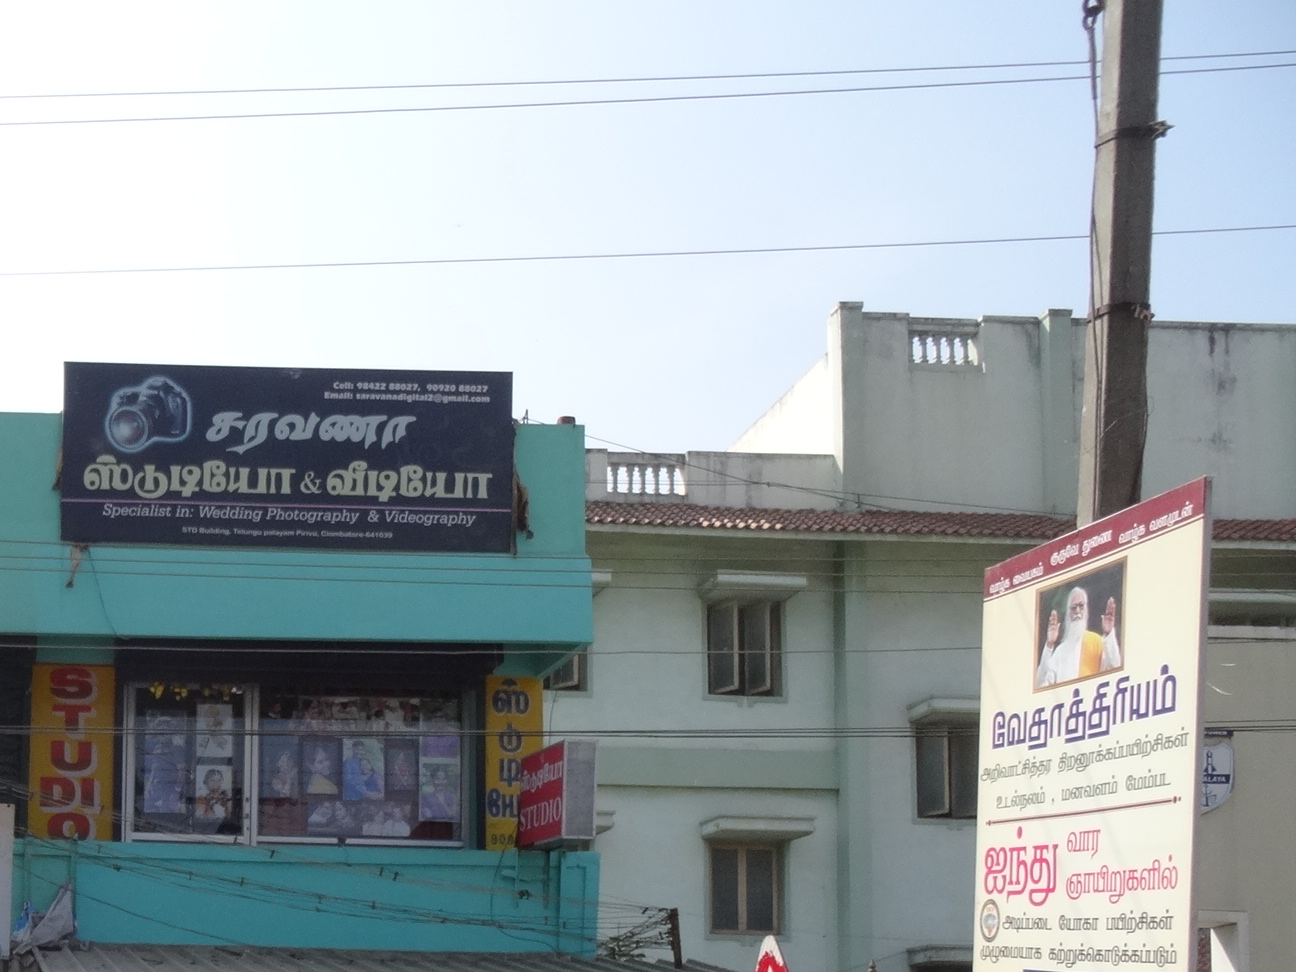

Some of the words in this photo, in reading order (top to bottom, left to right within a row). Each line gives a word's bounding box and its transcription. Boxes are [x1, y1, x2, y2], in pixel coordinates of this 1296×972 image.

[206, 411, 416, 454] சரவணா
[83, 454, 295, 498] ஸ்டுடியோ
[299, 474, 322, 495] &
[326, 460, 493, 501] வீடியோ
[102, 503, 172, 518] Specialist
[176, 504, 194, 518] in:
[198, 505, 262, 522] Wedding
[266, 507, 359, 525] Photography
[368, 511, 380, 522] &
[384, 511, 476, 526] Videography
[991, 664, 1178, 751] வேதாத்திரியம்
[39, 666, 99, 841] STUDIO
[1061, 775, 1118, 801] மனவளம்
[1125, 769, 1172, 792] மேம்பட
[520, 797, 562, 832] STUDIO
[1066, 829, 1101, 859] வார
[984, 827, 1058, 906] ஐந்து
[1065, 855, 1179, 904] ஞாயிறுகளில்
[1002, 912, 1052, 933] அடிப்படை
[1058, 914, 1099, 931] யோகா
[1106, 909, 1174, 934] பயிற்சிகள்
[980, 945, 1042, 964] முழுமையாக
[1049, 942, 1178, 968] கற்றுக்கொடுக்கப்படும்
